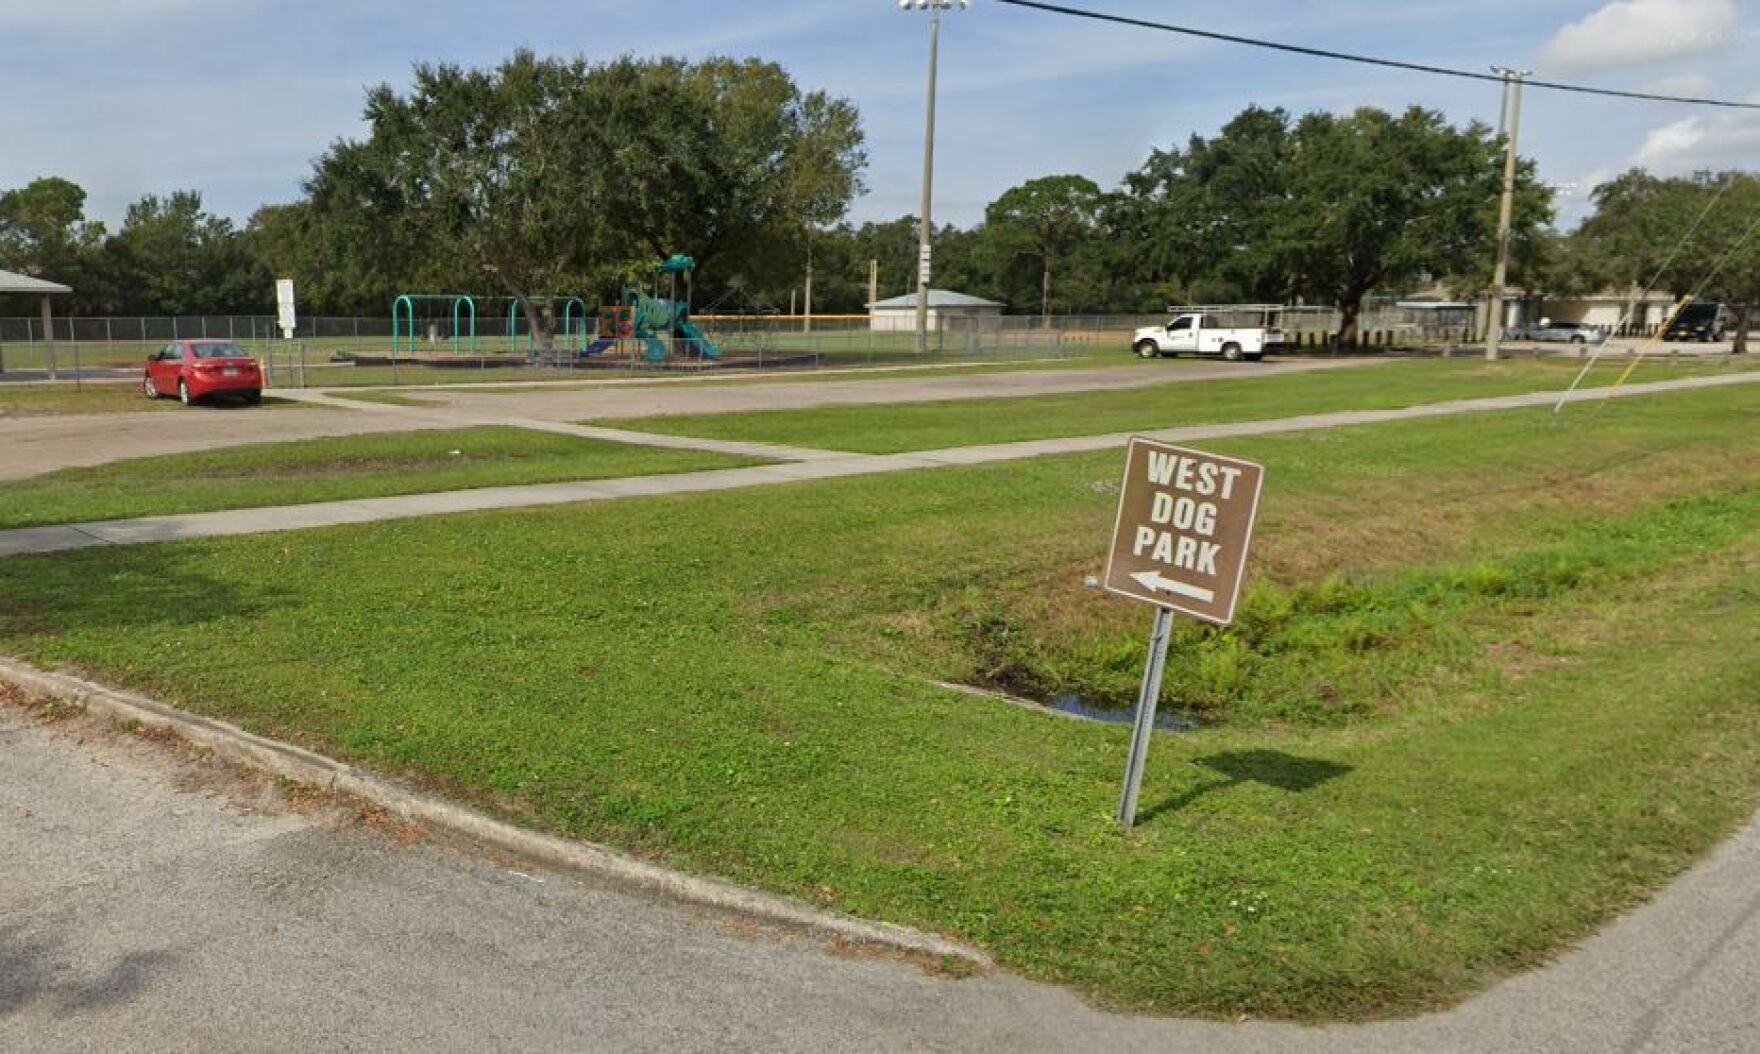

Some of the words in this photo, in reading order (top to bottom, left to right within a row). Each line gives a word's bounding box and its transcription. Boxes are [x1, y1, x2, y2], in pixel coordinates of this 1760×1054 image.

[1148, 451, 1242, 499] WEST
[1151, 491, 1217, 536] DOG
[1133, 526, 1221, 575] PARK
